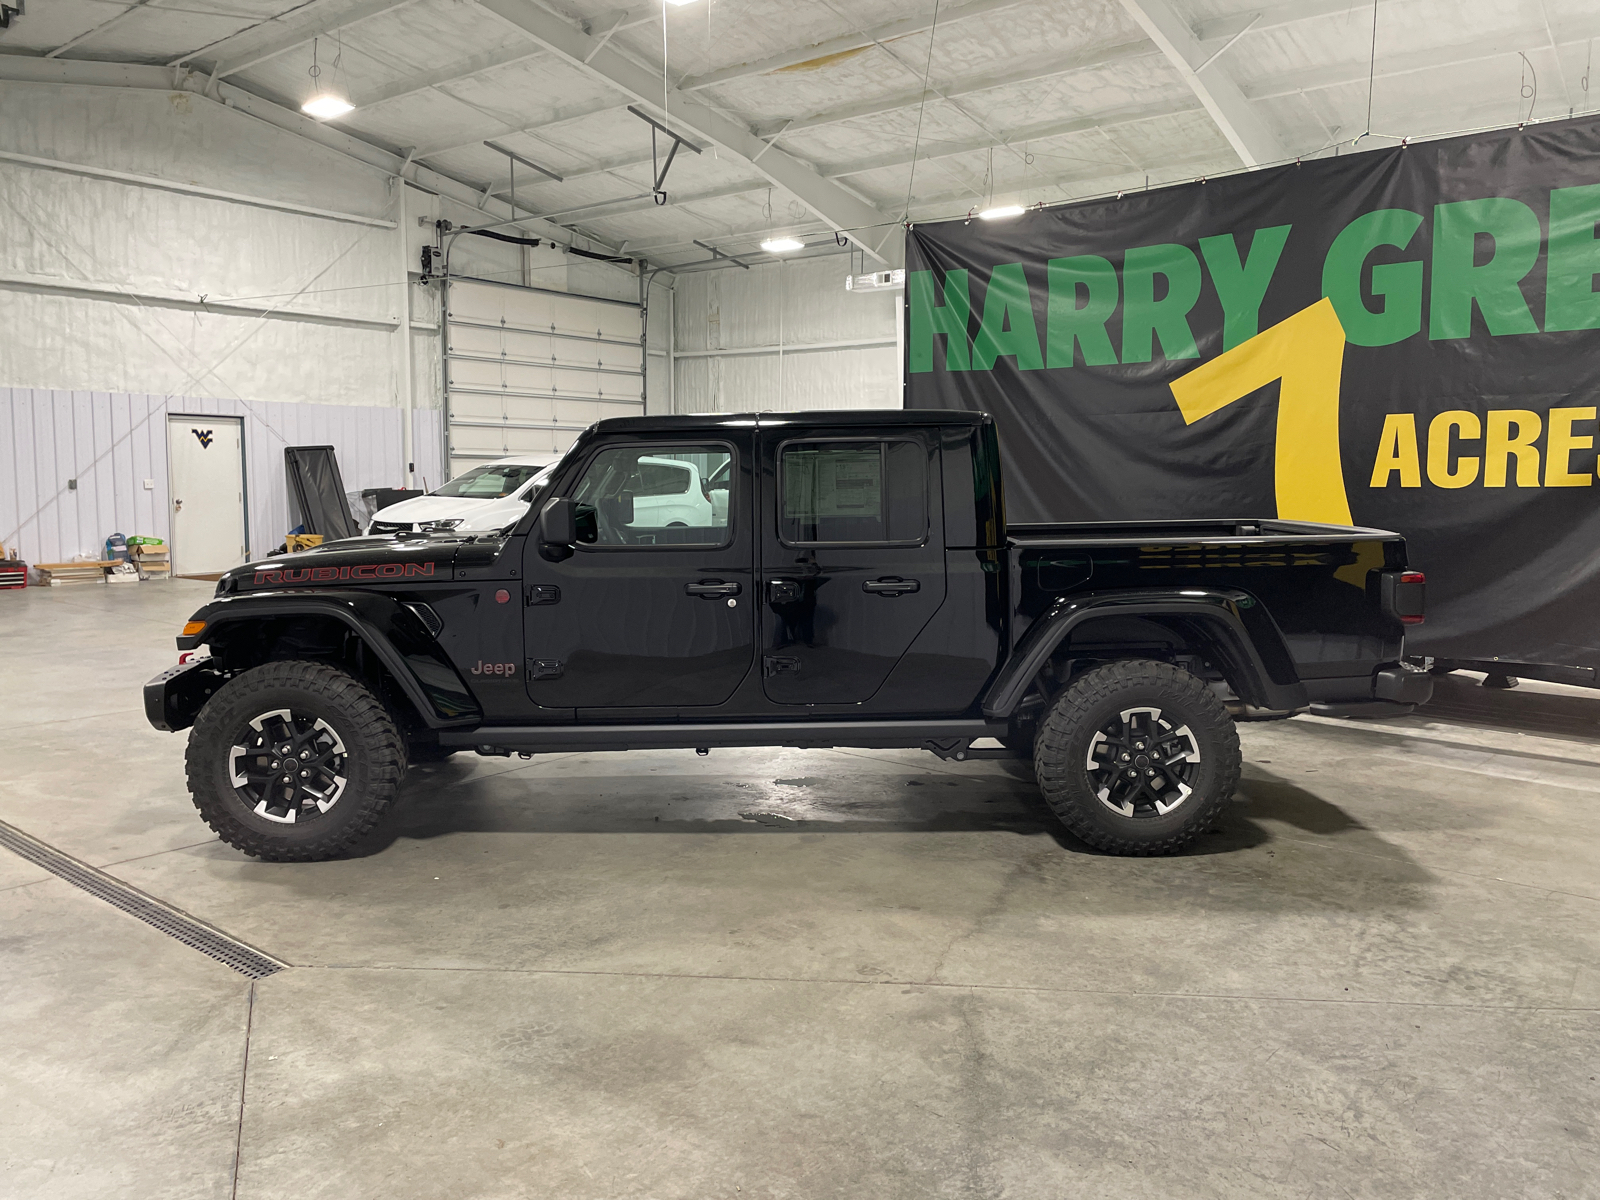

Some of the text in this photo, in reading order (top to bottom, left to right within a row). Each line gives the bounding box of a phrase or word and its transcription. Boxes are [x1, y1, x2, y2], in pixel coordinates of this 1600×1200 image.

[909, 224, 1293, 374] HARRY
[1369, 406, 1600, 489] ACRE
[253, 562, 435, 585] RUBICON
[470, 660, 516, 678] Jeep
